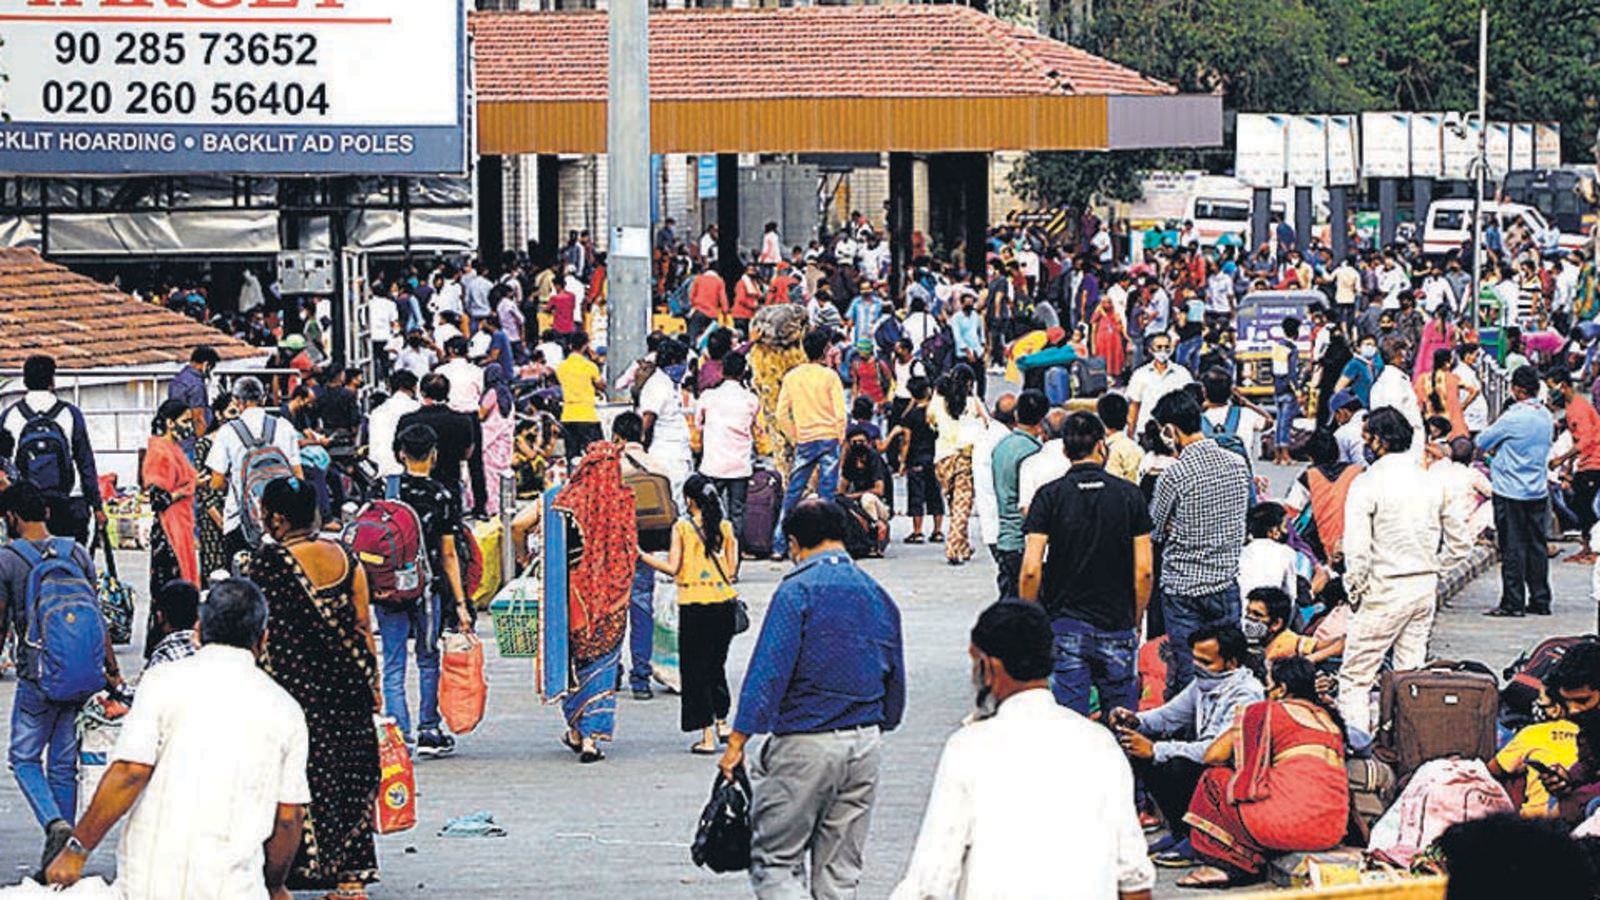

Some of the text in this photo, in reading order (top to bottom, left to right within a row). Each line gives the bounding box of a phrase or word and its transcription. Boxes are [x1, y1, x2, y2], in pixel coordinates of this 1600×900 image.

[54, 31, 317, 66] 90 285 73652
[42, 79, 330, 116] 020 260 56404
[0, 131, 414, 154] KLIT HOARDING BACKLIT AD POLES
